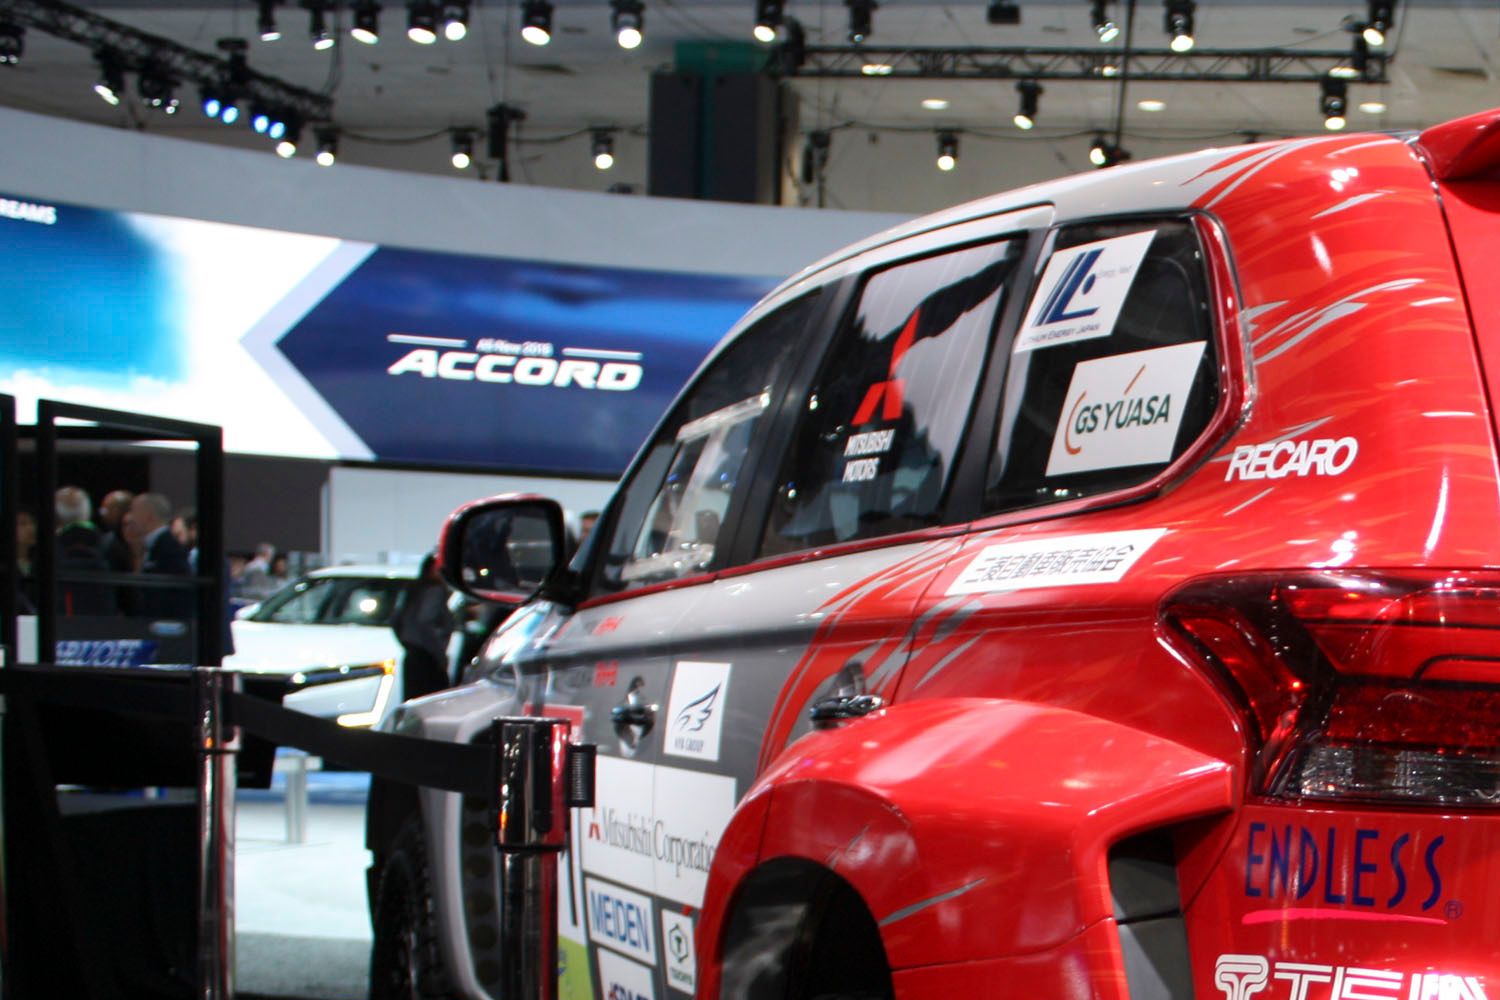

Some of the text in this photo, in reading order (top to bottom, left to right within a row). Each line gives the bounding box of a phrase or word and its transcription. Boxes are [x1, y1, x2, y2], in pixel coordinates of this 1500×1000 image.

[387, 348, 644, 392] ACCORD
[1075, 393, 1172, 435] GS YUASA
[1224, 436, 1358, 482] RECARO
[653, 819, 717, 878] Corporatio
[1244, 821, 1445, 912] ENDLESS
[590, 889, 650, 953] MEIDEN
